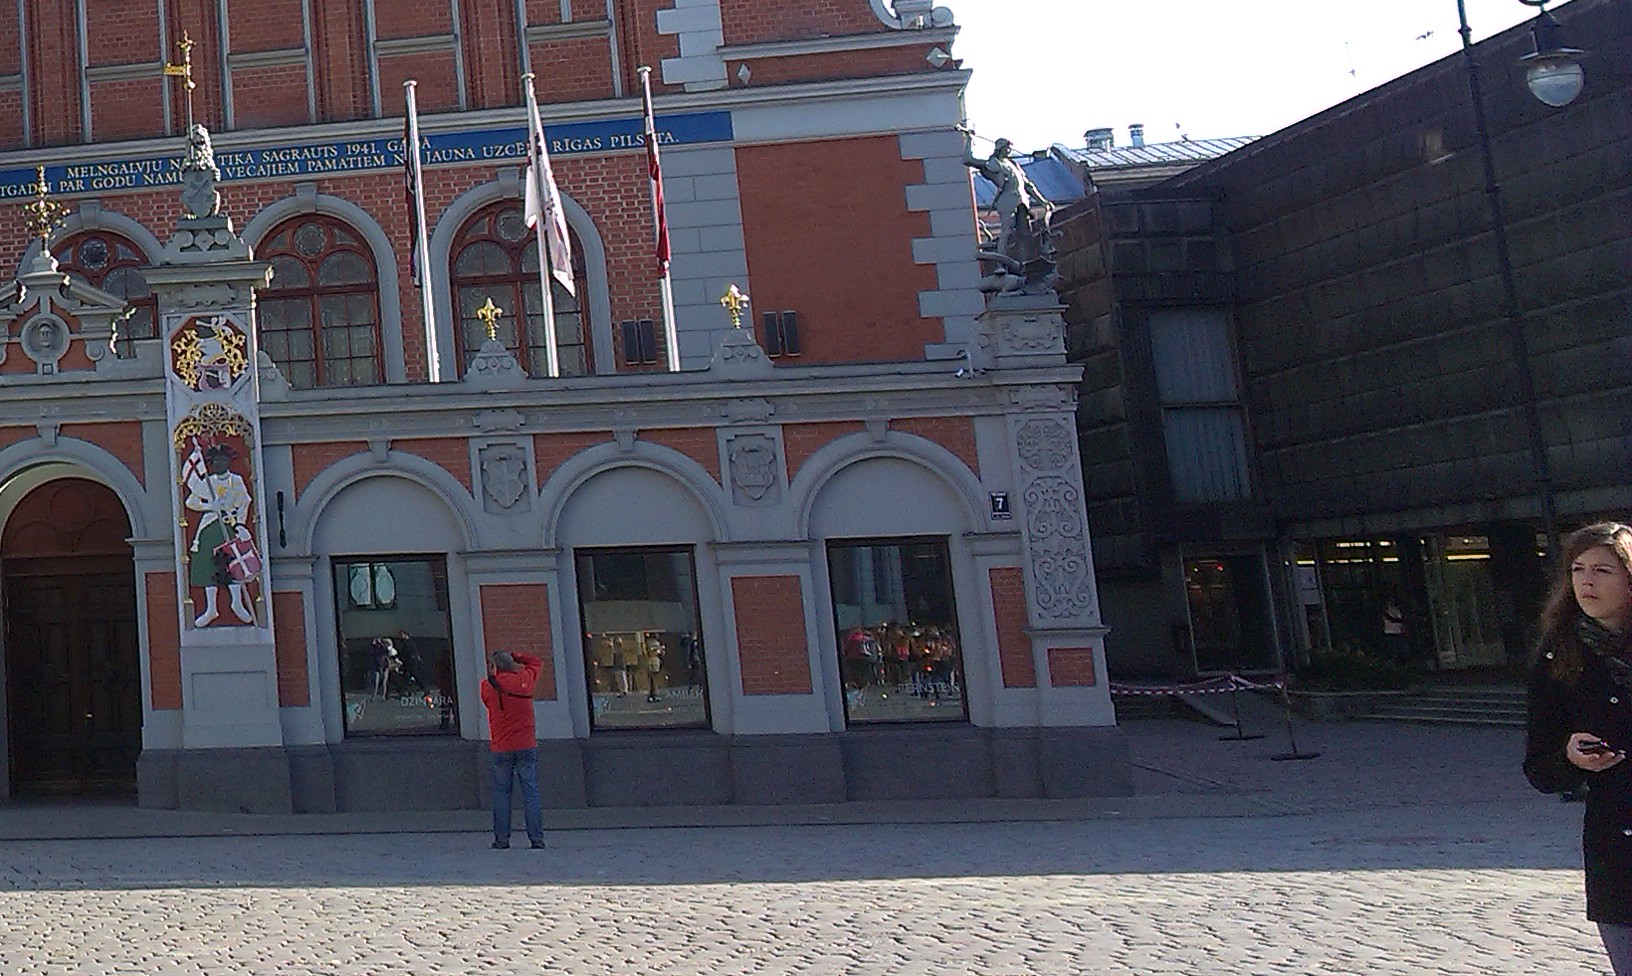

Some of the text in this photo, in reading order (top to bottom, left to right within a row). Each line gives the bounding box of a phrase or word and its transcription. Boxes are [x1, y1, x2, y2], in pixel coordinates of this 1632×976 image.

[59, 179, 85, 192] PAR
[92, 175, 136, 189] GODU
[226, 162, 300, 178] VECAJIEM
[308, 155, 386, 172] PAMATIEM
[425, 148, 475, 165] JAUNA
[610, 131, 679, 148] PILSTA.
[67, 160, 163, 179] MELNGALVJU
[217, 152, 255, 166] TIKA
[262, 145, 338, 163] SAGRAUTS
[347, 142, 380, 155] 1941.
[995, 497, 1004, 509] 7
[400, 695, 453, 706] DZINARA
